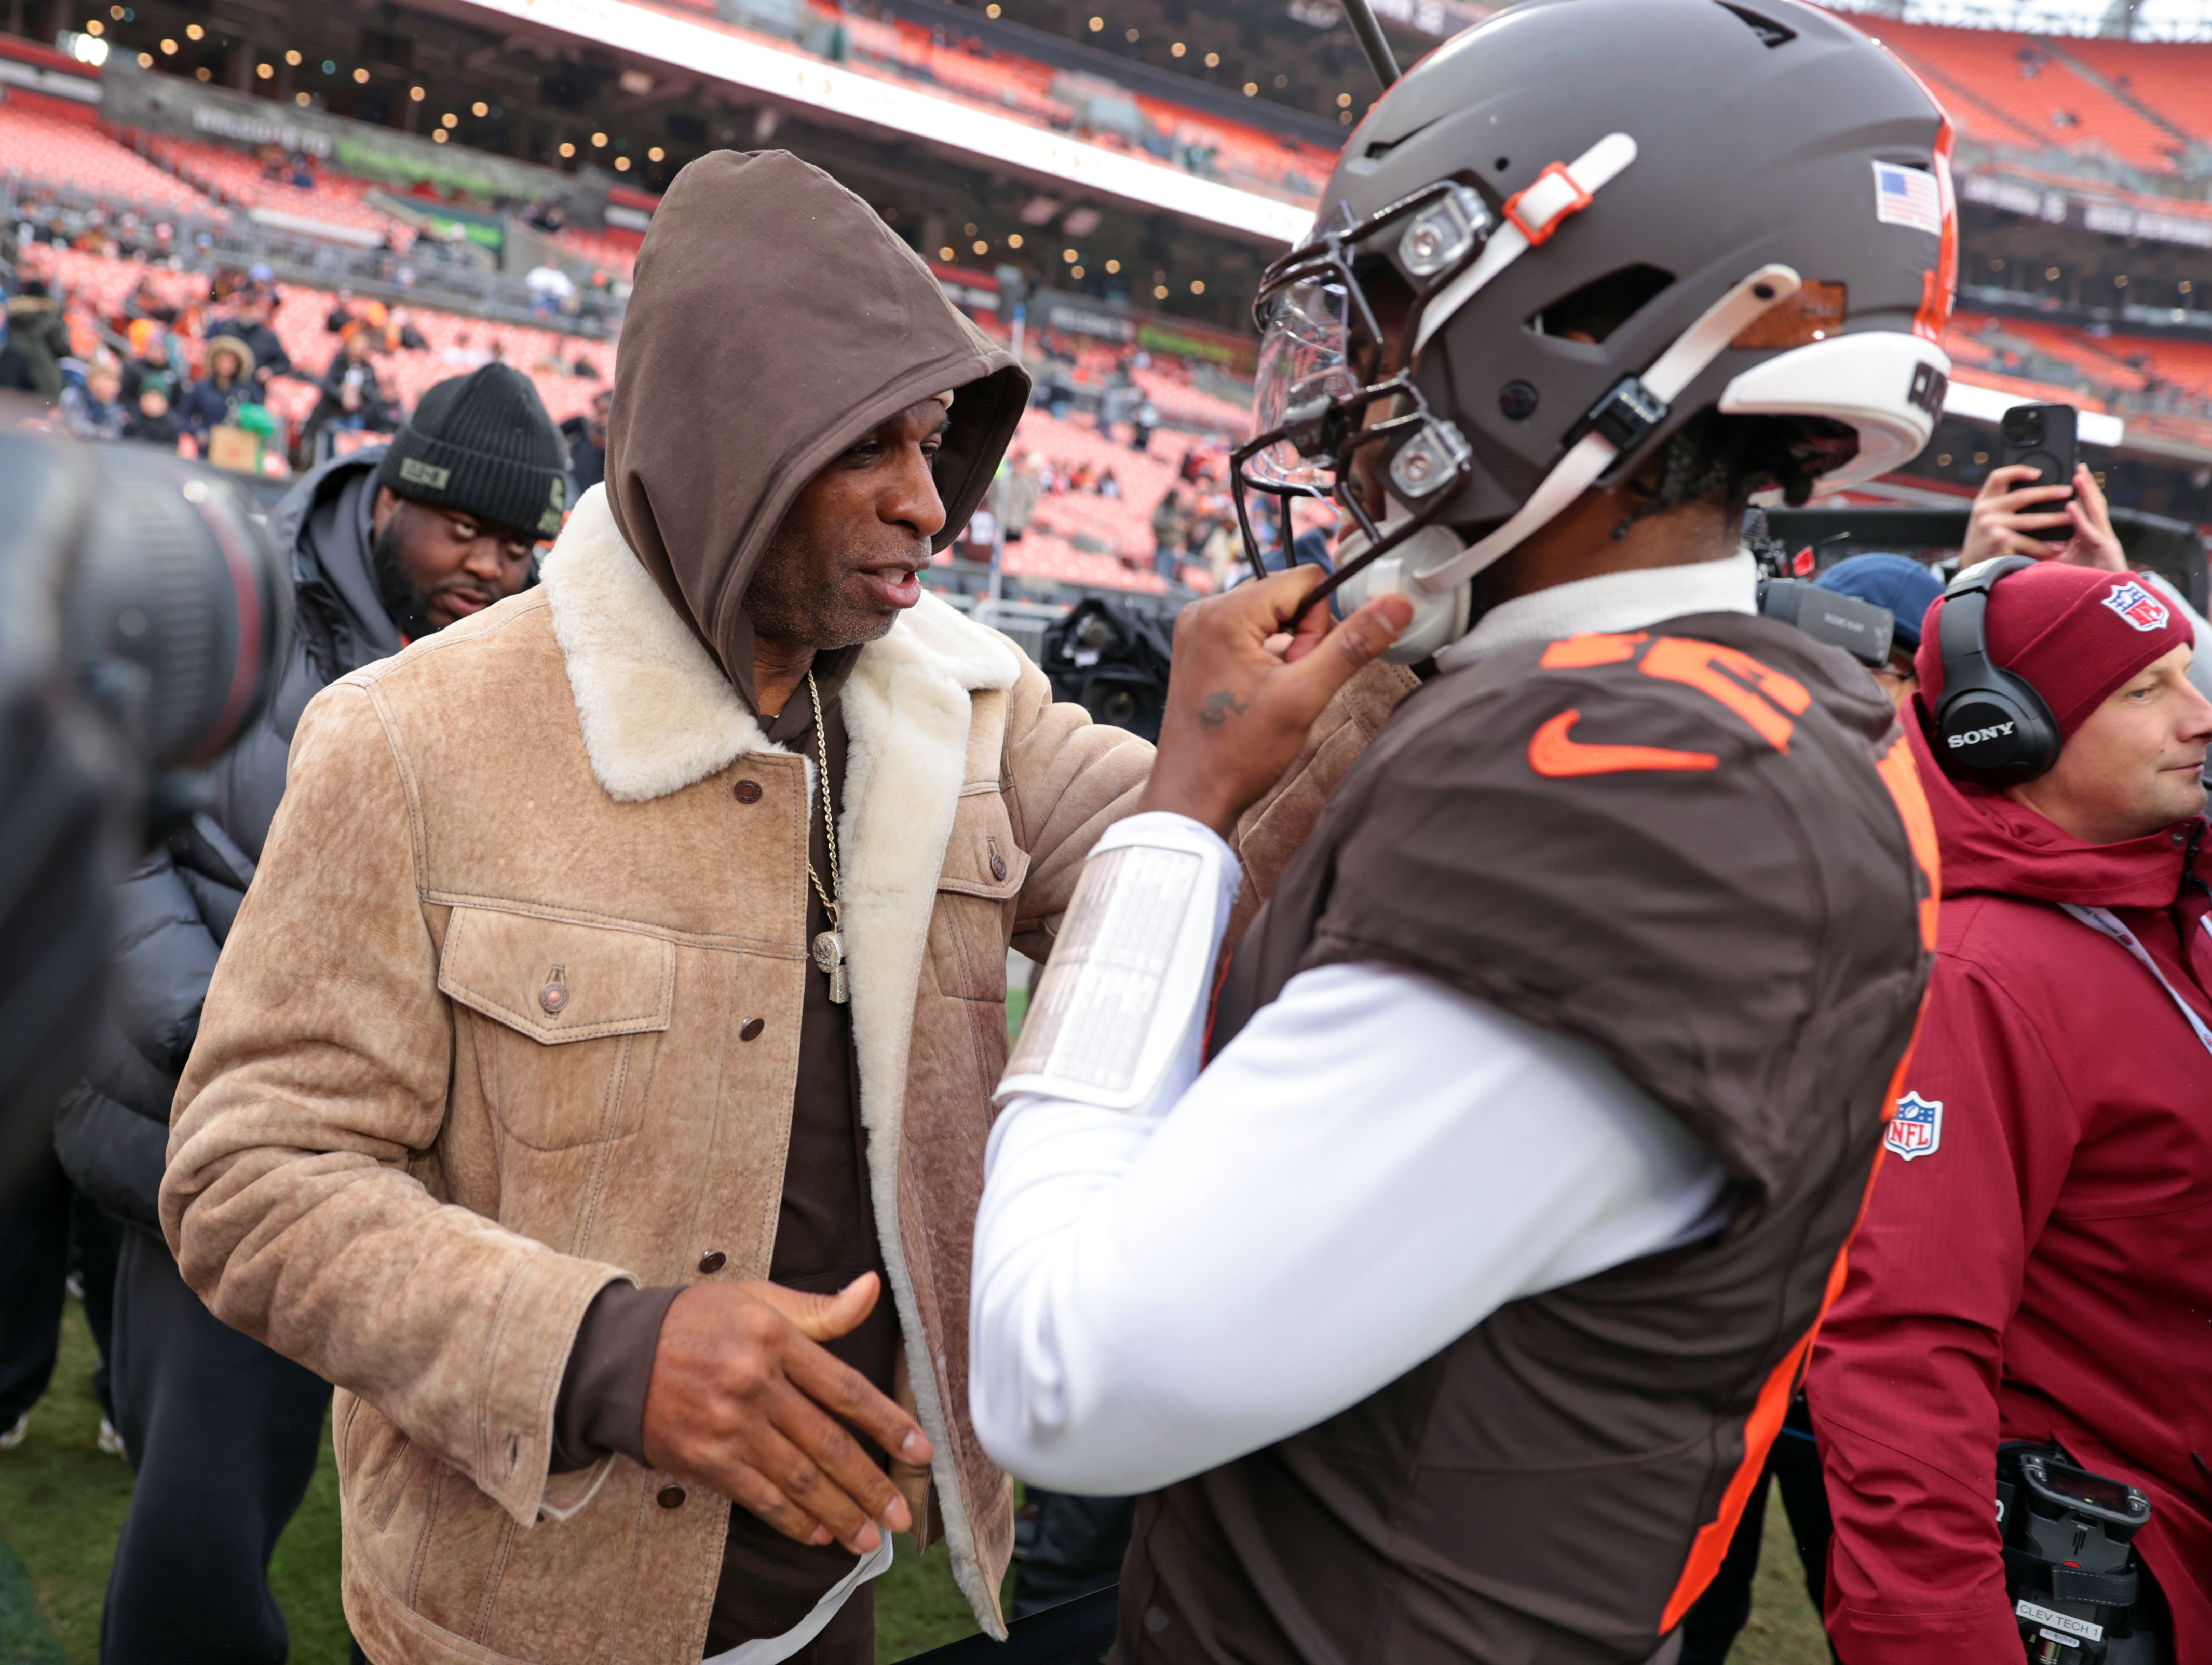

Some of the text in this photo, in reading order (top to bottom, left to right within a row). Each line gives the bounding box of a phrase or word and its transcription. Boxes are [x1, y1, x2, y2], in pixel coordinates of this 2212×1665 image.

[2126, 598, 2164, 626] NFL
[1947, 721, 2015, 749] SONY
[1890, 1121, 1929, 1148] NFL
[2020, 1604, 2098, 1637] CLEV TECH 1
